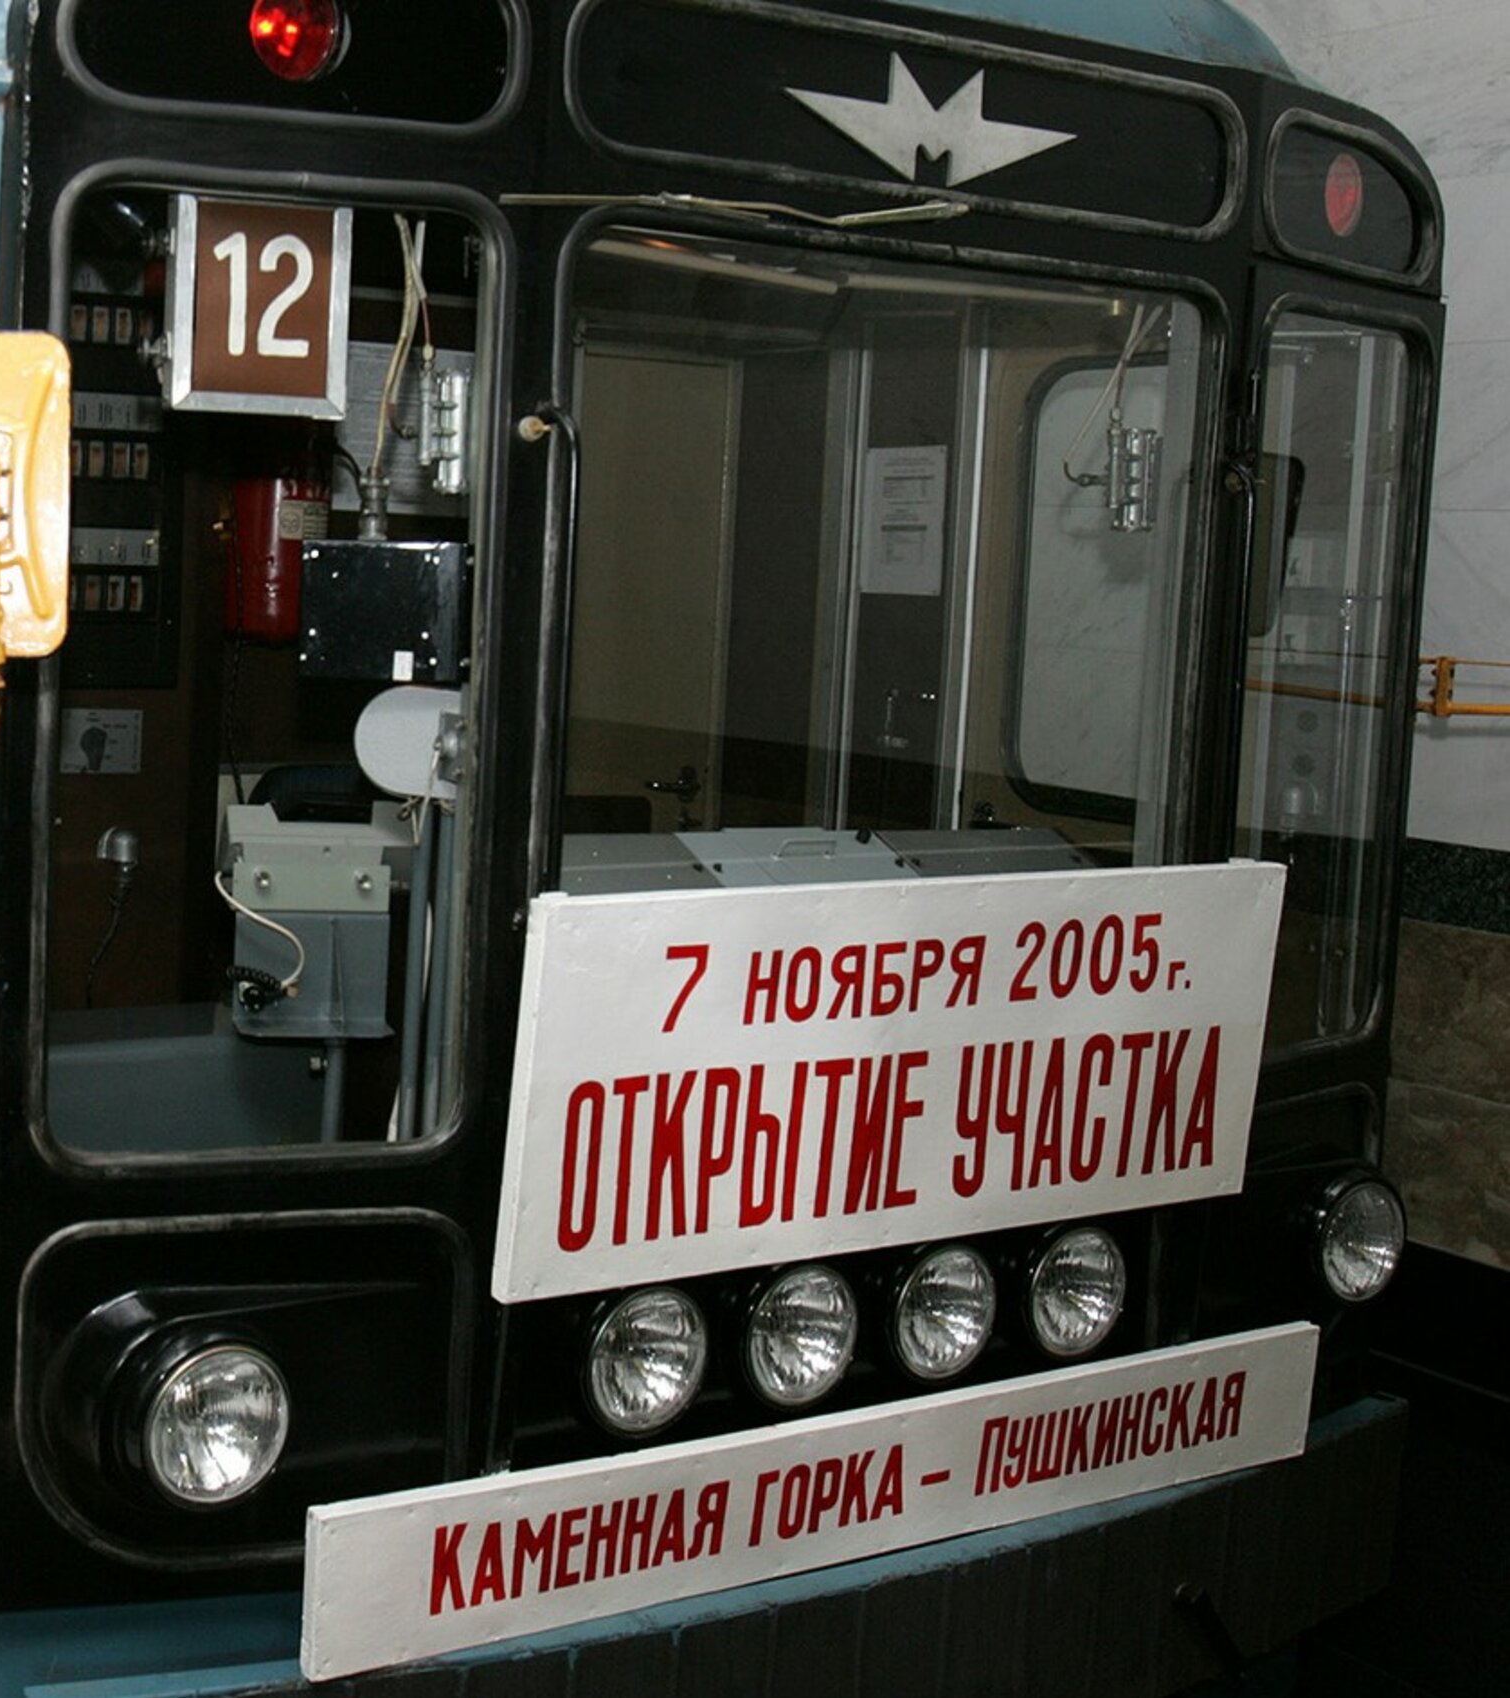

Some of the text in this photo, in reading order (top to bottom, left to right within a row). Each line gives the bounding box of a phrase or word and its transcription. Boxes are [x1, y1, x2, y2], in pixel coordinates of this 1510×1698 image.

[213, 231, 315, 358] 12
[662, 944, 709, 1033] 7
[743, 935, 987, 1026] НОЯБРЯ
[557, 1025, 1222, 1254] ОТКРЫТИЕ УЧАСТКА
[428, 1480, 730, 1616] КАМЕННАЯ
[748, 1444, 904, 1548] ГОРКА
[974, 1371, 1246, 1497] ПУШКИНСКАЯ
